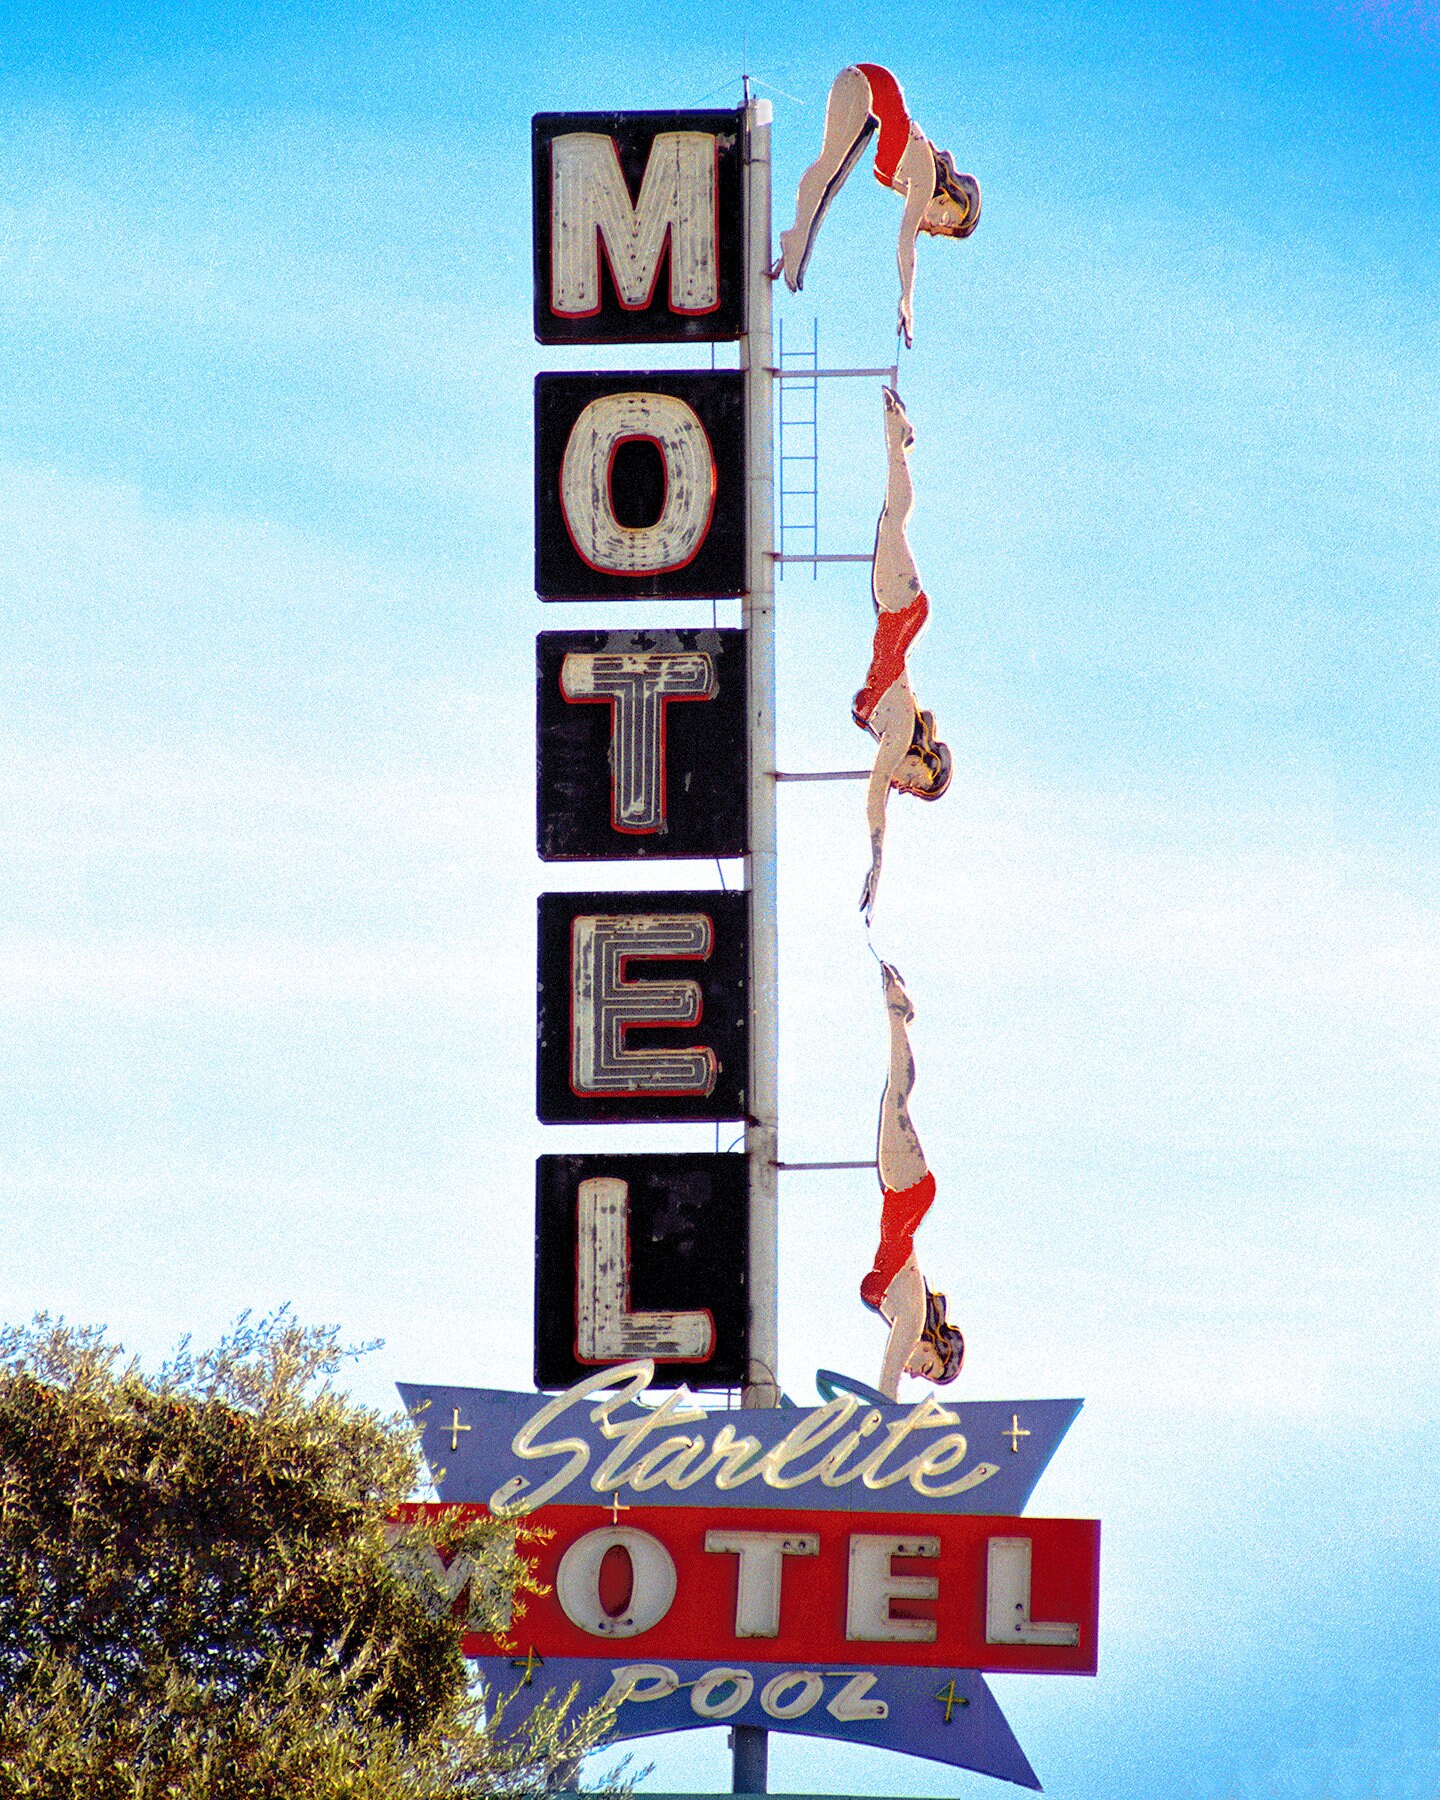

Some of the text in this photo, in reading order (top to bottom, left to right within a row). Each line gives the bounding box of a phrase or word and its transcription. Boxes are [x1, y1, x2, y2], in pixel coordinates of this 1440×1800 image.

[550, 131, 721, 1364] MOTEL
[489, 1358, 1001, 1517] Starlite
[601, 1664, 889, 1722] POOL
